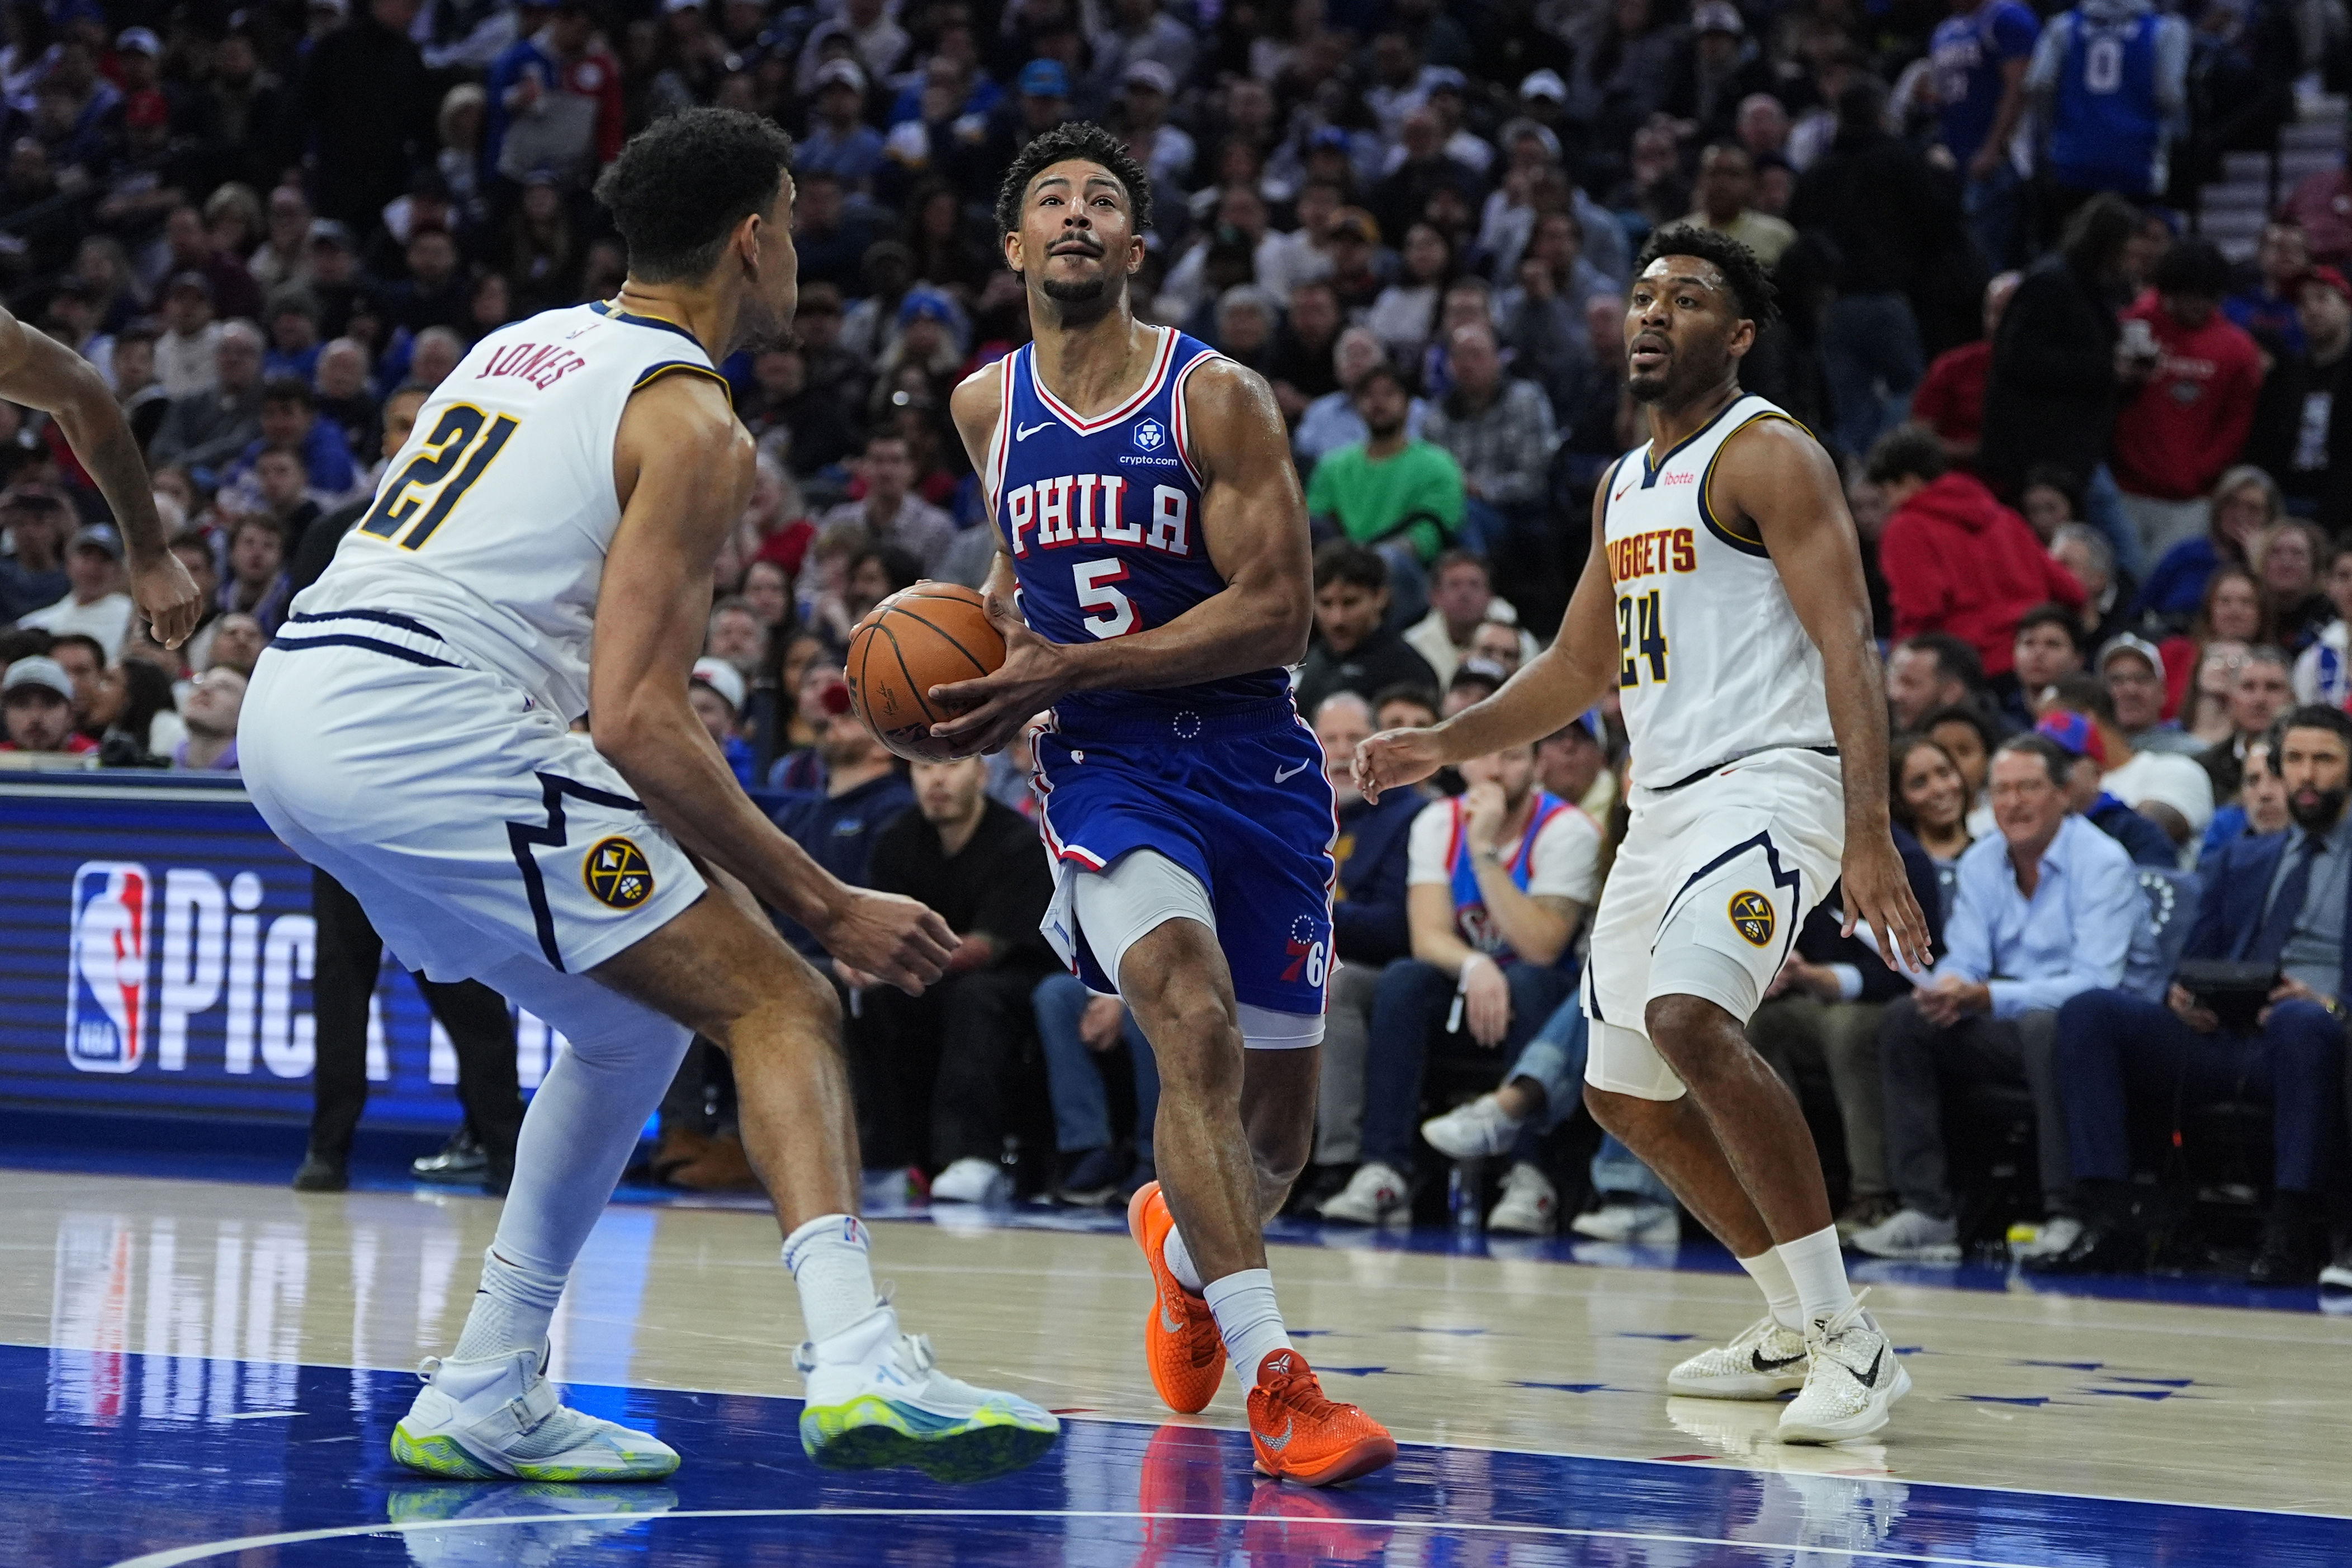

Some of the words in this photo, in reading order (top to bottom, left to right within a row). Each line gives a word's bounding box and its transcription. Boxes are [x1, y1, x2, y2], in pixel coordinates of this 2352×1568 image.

[475, 343, 585, 391] JONES
[357, 401, 521, 552] 21
[1119, 455, 1178, 466] crypto.com
[1664, 471, 1694, 486] ibotta
[1007, 473, 1192, 559] PHILA
[1606, 528, 1697, 586] UGGETS
[1072, 557, 1143, 641] 5
[1617, 589, 1669, 689] 24
[158, 868, 390, 1082] Pic
[1280, 937, 1324, 988] 76
